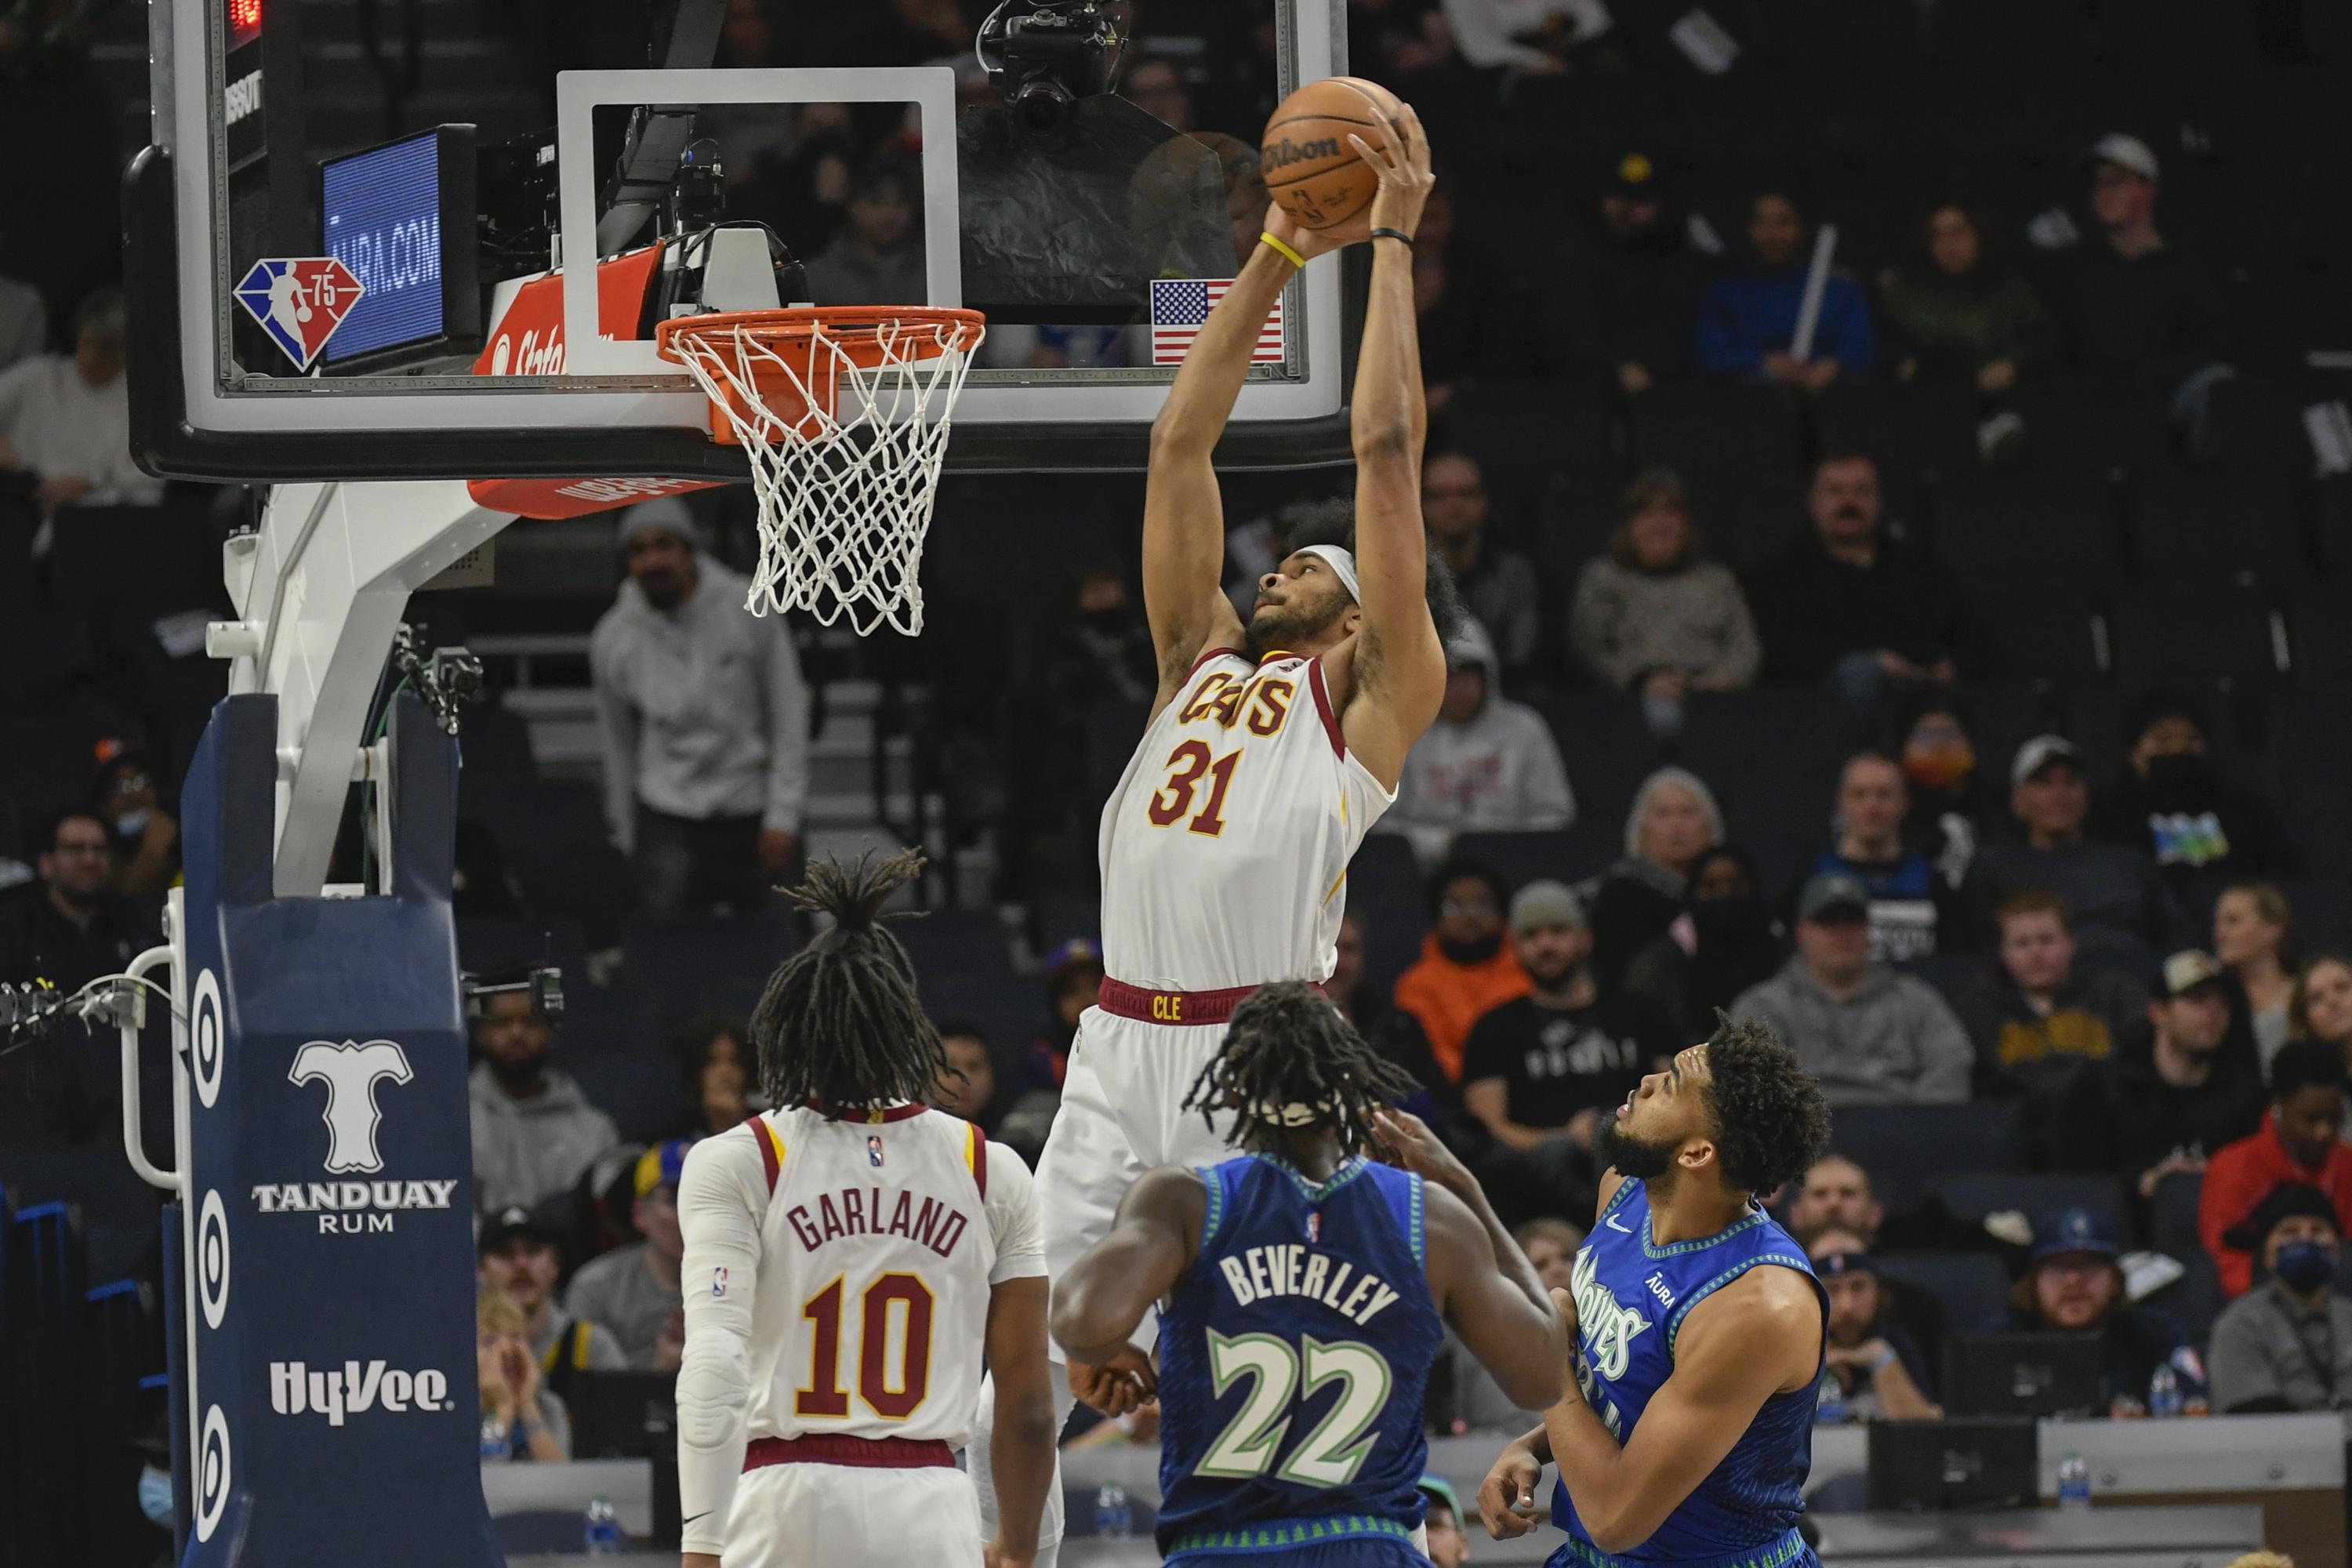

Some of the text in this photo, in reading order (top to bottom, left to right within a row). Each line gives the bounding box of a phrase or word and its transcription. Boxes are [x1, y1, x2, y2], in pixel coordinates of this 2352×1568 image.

[310, 274, 336, 307] 75
[1148, 739, 1244, 838] 31
[1153, 995, 1181, 1021] CLE
[251, 1179, 459, 1212] TANDUAY
[318, 1213, 394, 1234] RUM
[786, 1187, 968, 1258] GARLAND
[1218, 1244, 1400, 1327] BEVERLEY
[1570, 1244, 1653, 1381] WOLVES
[794, 1271, 936, 1421] 10
[1192, 1326, 1393, 1489] 22
